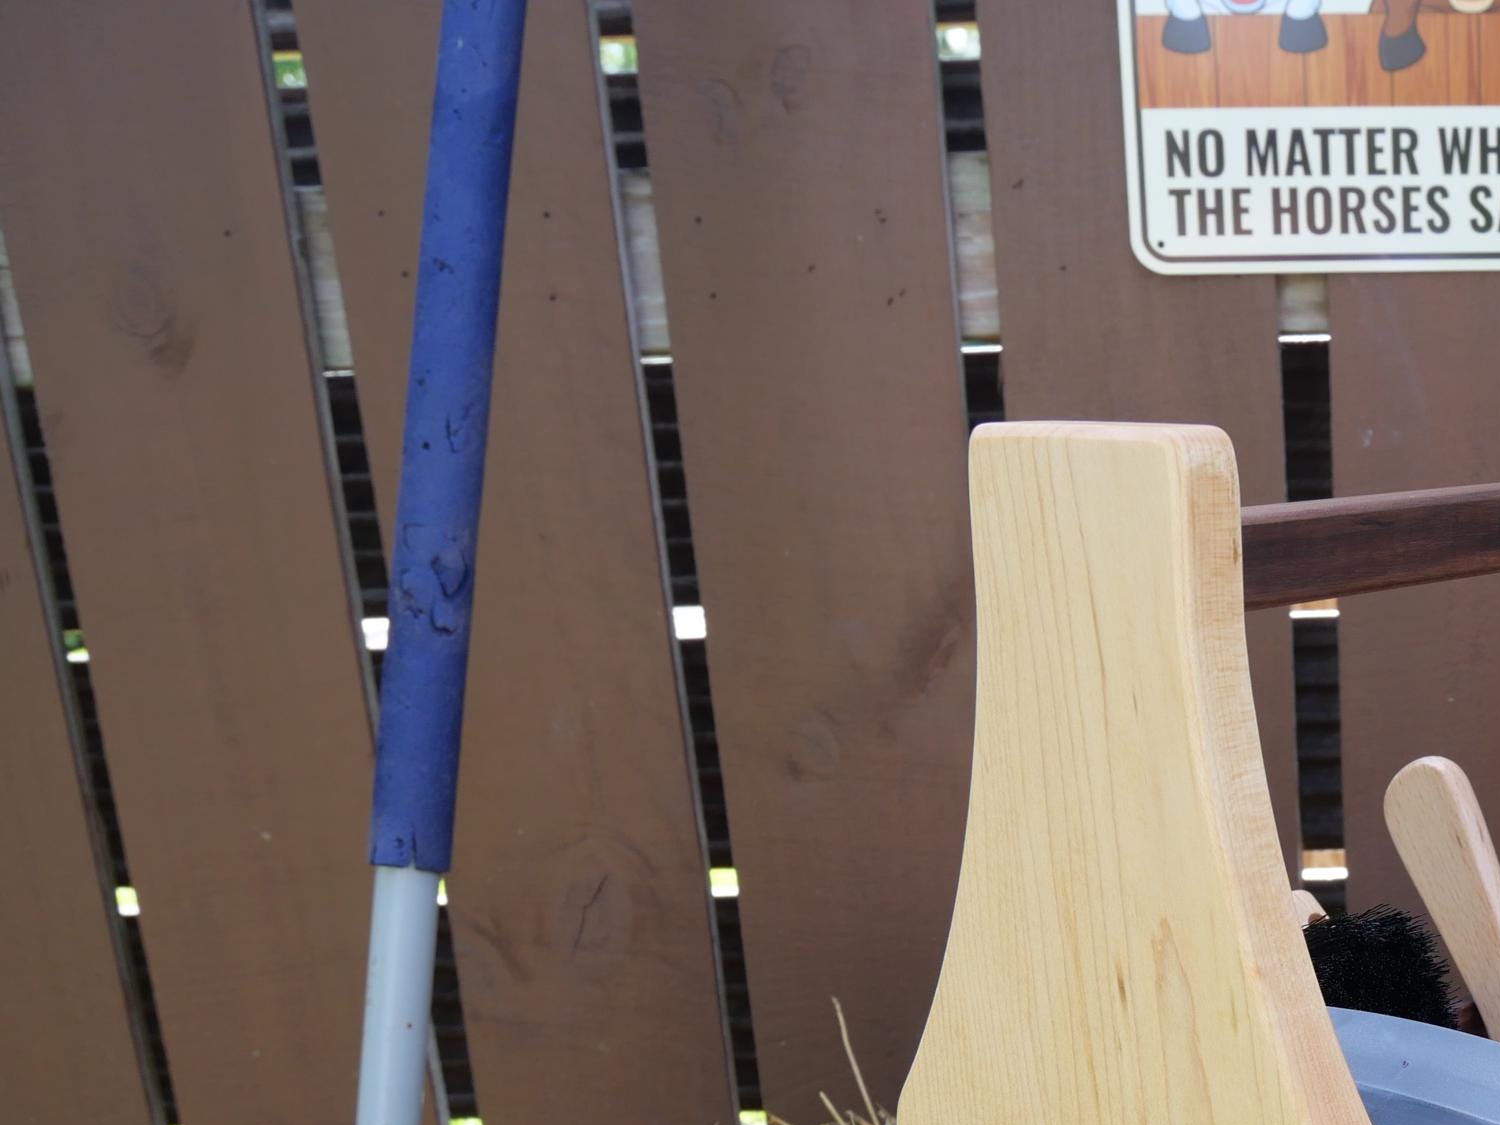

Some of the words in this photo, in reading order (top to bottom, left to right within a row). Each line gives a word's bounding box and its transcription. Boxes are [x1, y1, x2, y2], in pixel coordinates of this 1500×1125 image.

[1164, 128, 1226, 178] NO
[1246, 126, 1420, 177] MATTER
[1168, 187, 1253, 237] THE
[1271, 185, 1451, 236] HORSES
